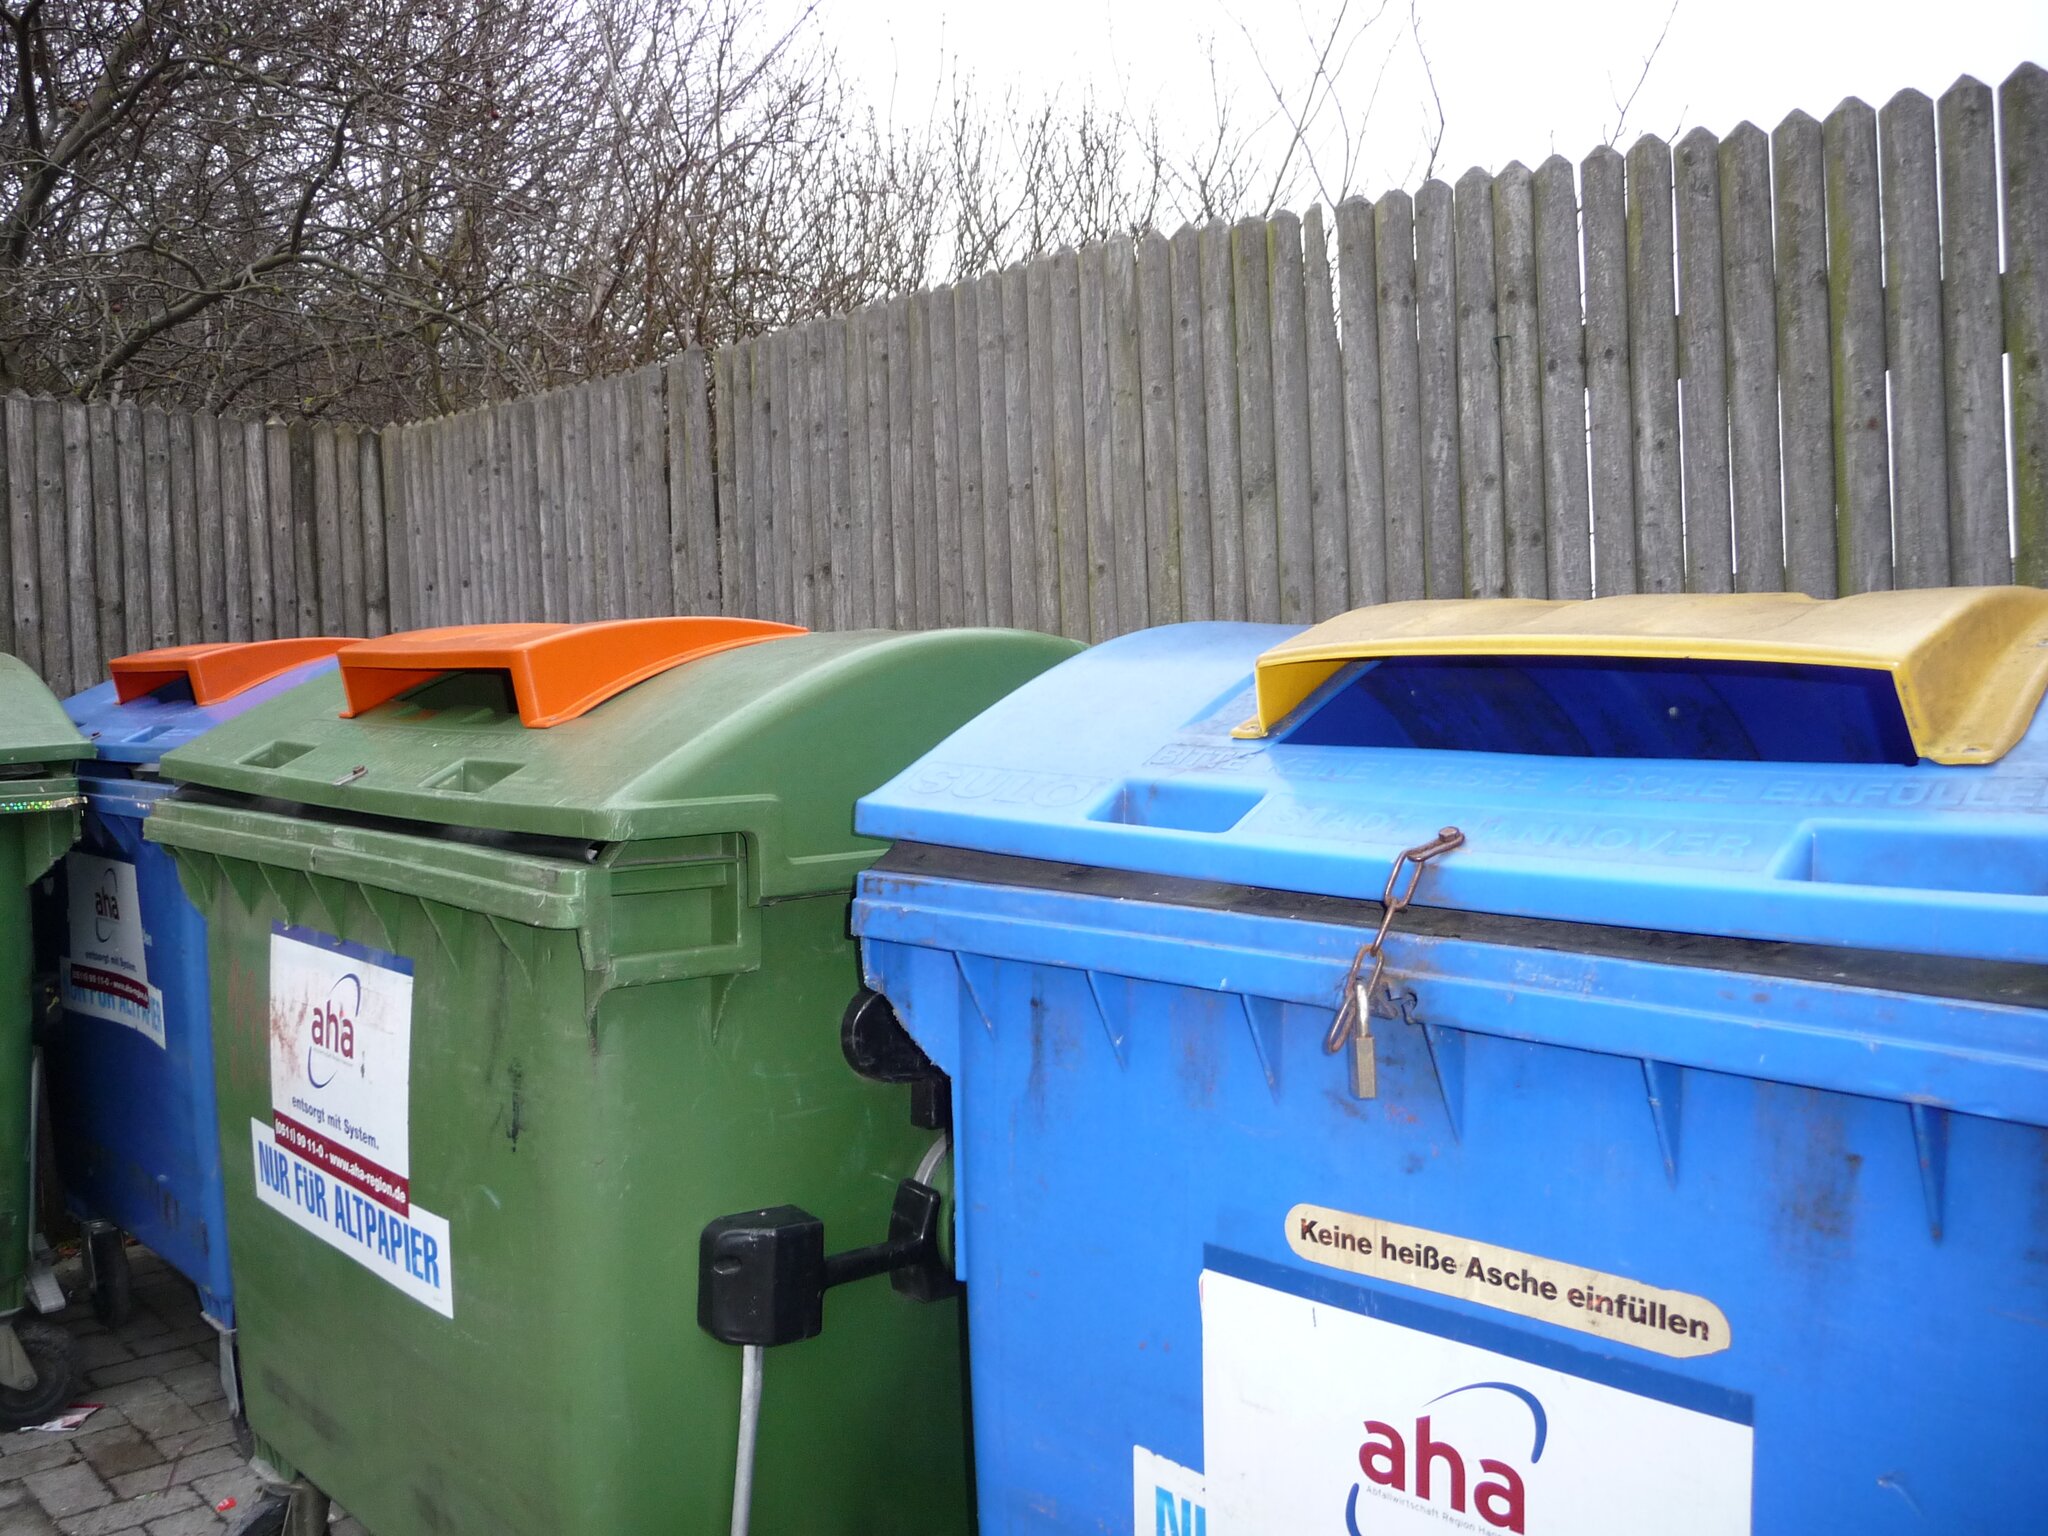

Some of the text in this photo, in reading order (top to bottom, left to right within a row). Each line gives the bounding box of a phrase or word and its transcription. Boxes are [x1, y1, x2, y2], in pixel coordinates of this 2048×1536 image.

[908, 764, 1096, 808] SULO
[94, 886, 120, 921] aha
[311, 1000, 354, 1059] aha
[291, 1095, 380, 1150] entsorgt mit System.
[275, 1118, 297, 1144] (0511)
[296, 1132, 306, 1149] 99
[329, 1152, 407, 1204] www.aha-region.de
[258, 1140, 441, 1289] NUR FÜR ALTPAPIER
[1299, 1218, 1710, 1341] Keine heiße Asche einfüllen
[1358, 1415, 1525, 1535] aha
[1366, 1485, 1440, 1520] Abfallwirtschaft
[1442, 1511, 1476, 1532] Region
